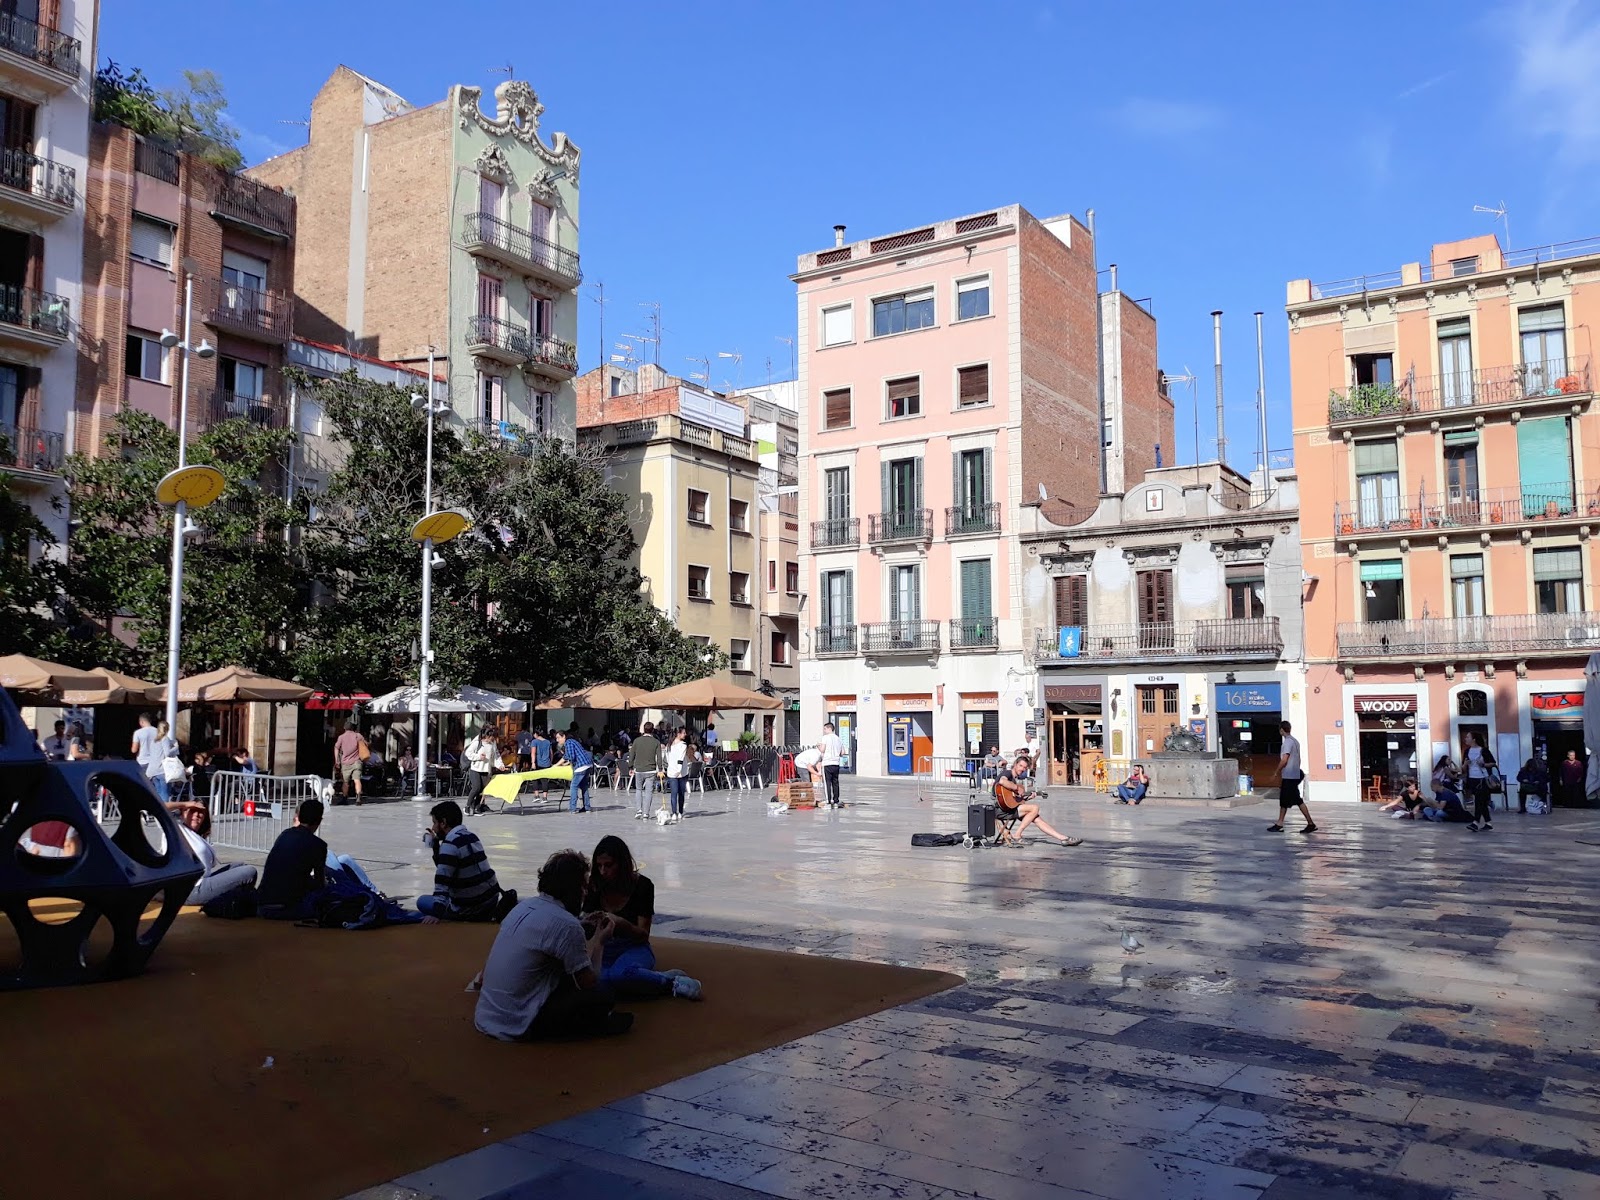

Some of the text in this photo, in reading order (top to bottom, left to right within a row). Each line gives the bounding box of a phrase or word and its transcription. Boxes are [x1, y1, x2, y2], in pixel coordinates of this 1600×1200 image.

[1045, 687, 1066, 698] SOL
[1075, 687, 1100, 698] NIT
[902, 698, 928, 707] Laundry
[1225, 691, 1242, 706] 16
[1360, 701, 1410, 712] WOODY
